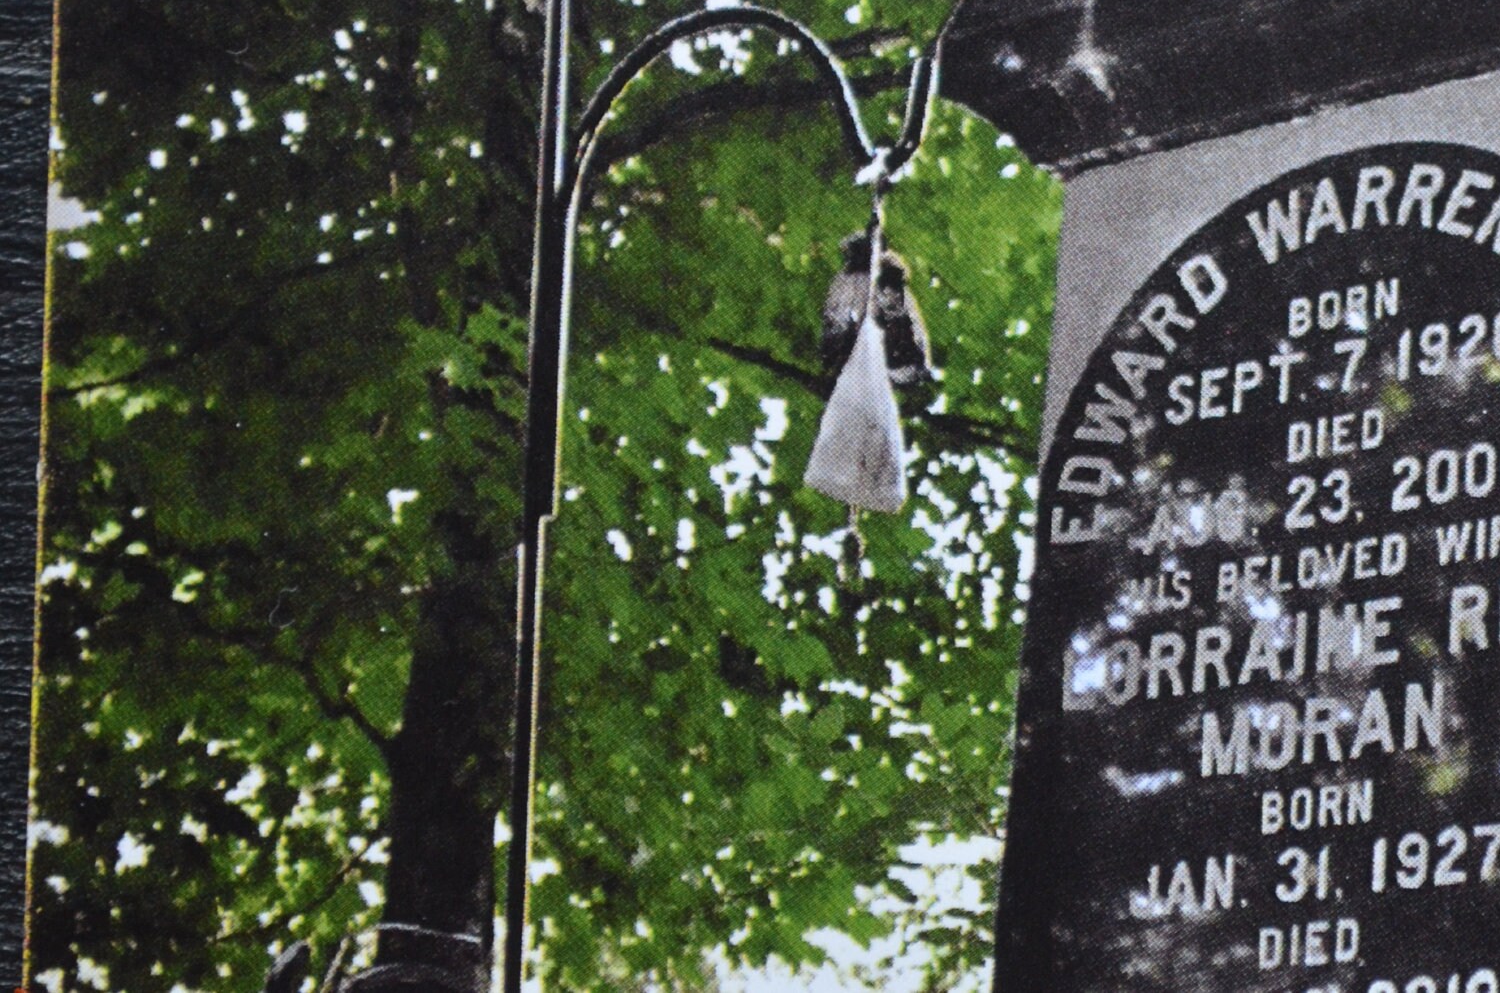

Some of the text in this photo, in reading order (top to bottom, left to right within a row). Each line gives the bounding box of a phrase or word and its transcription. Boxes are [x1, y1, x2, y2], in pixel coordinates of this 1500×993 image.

[1287, 277, 1400, 338] BORN
[1050, 255, 1228, 544] EDWARD
[1286, 408, 1385, 464] DIED
[1284, 468, 1365, 530] 23,
[1216, 532, 1408, 604] BELOVED
[1061, 596, 1403, 711] LORRAINE
[1200, 681, 1444, 778] MORAN
[1260, 779, 1374, 836] BORN
[1131, 853, 1249, 917] JAN.
[1274, 846, 1345, 904] 31,
